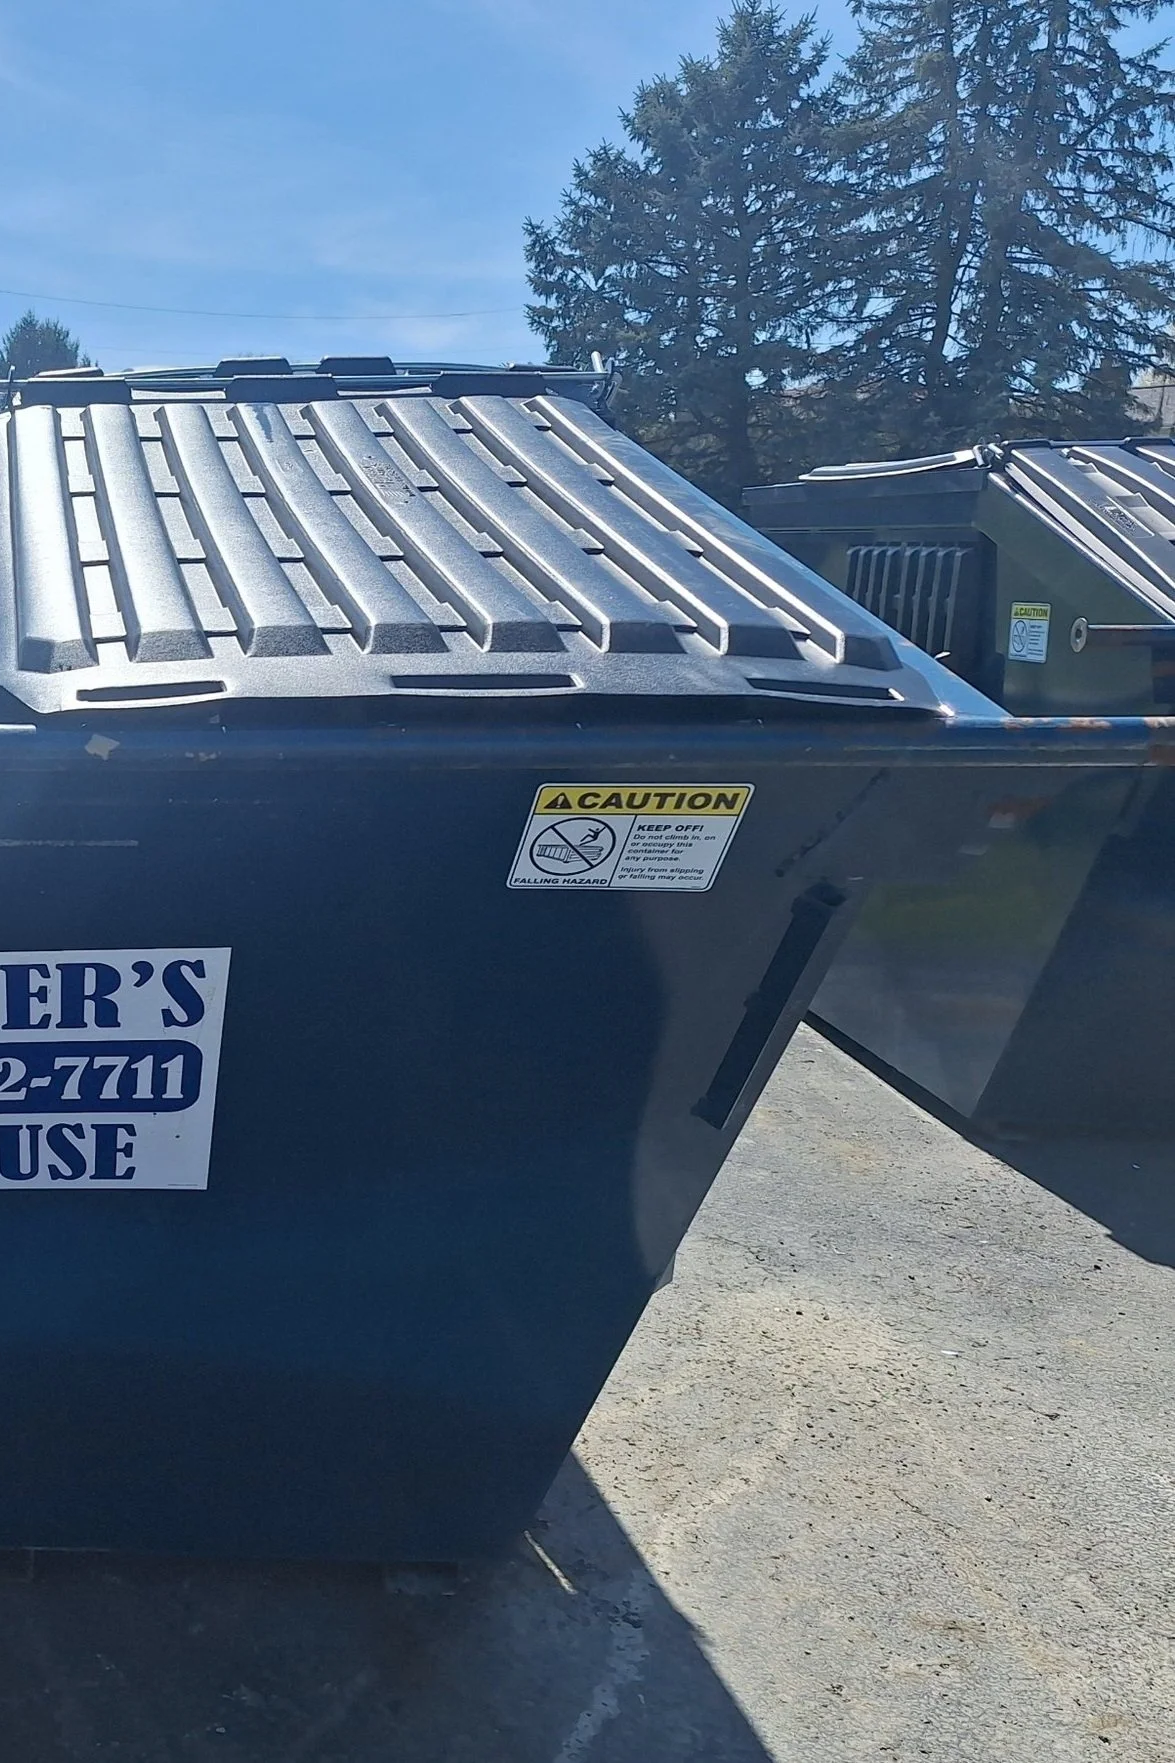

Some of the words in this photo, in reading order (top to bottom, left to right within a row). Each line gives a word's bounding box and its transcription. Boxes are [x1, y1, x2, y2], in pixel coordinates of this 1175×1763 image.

[577, 792, 741, 810] CAUTION
[637, 824, 672, 832] KEEP
[674, 824, 705, 832] OFF!
[513, 877, 560, 885] FALLING
[562, 877, 608, 886] HAZARD
